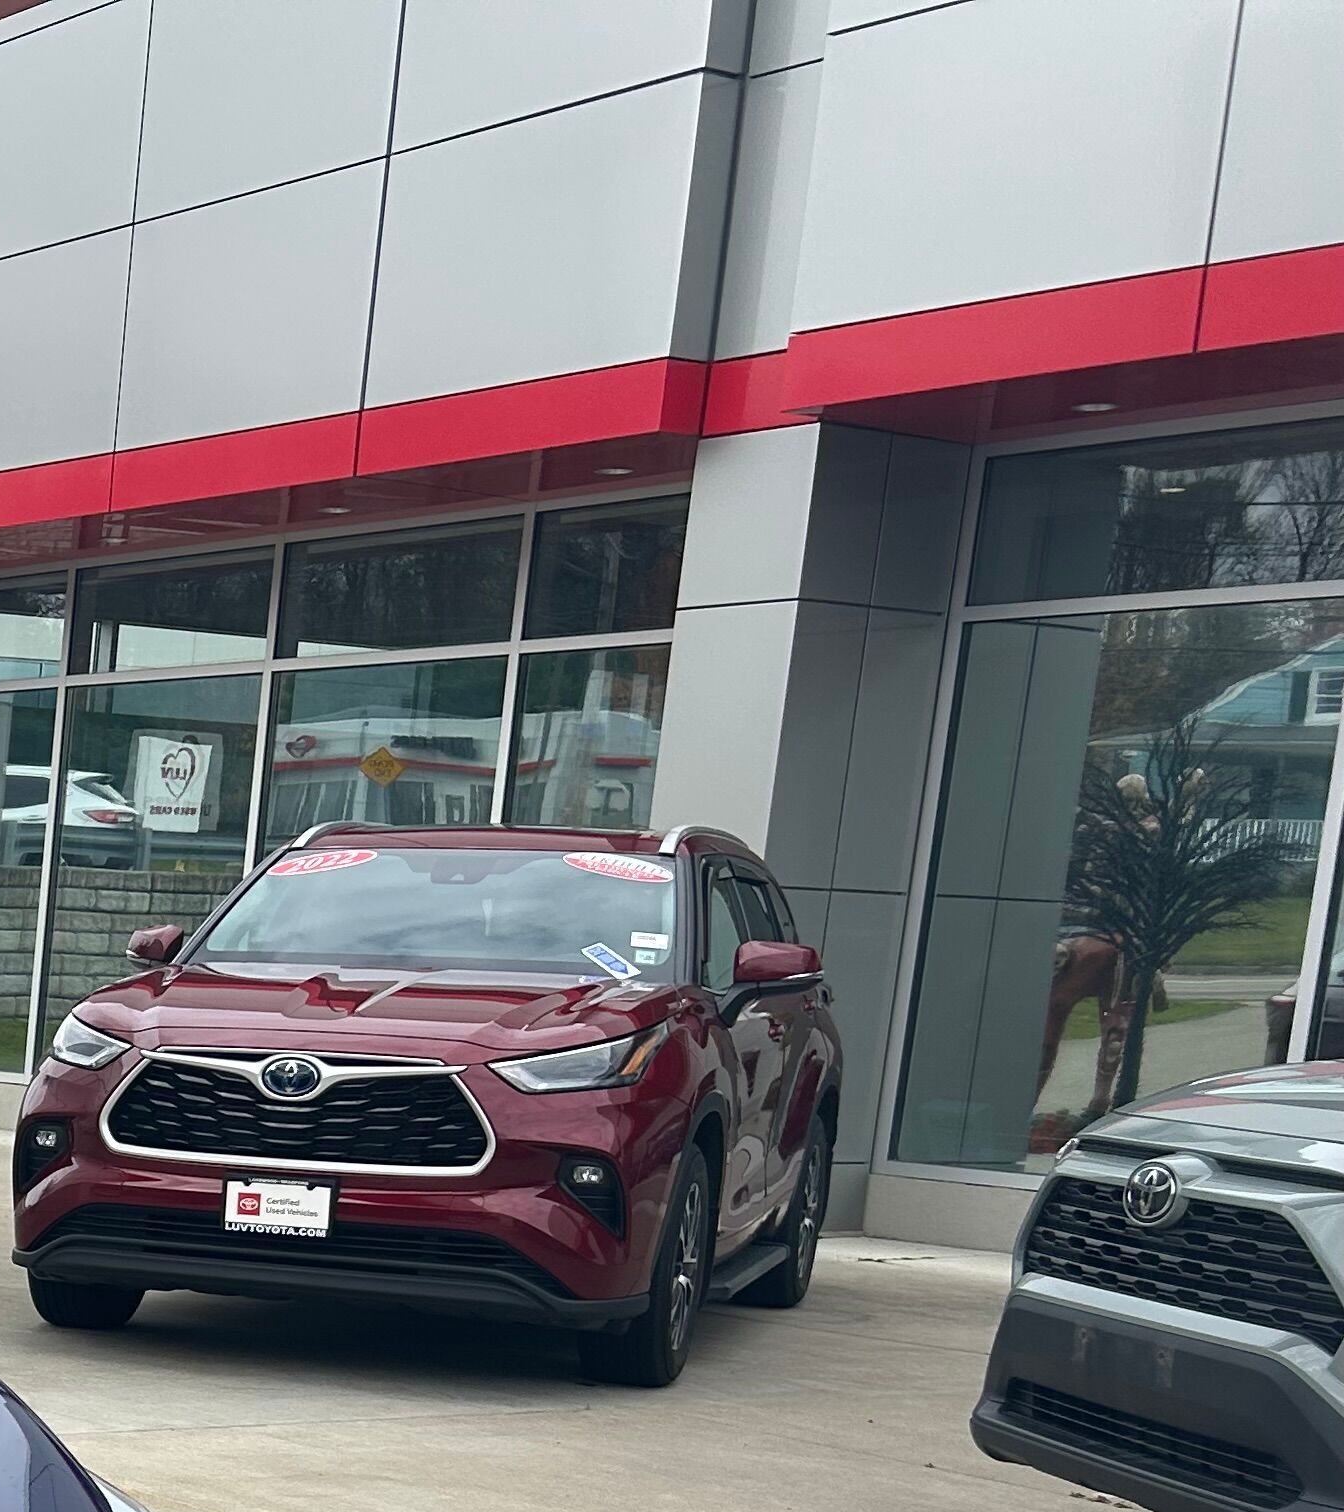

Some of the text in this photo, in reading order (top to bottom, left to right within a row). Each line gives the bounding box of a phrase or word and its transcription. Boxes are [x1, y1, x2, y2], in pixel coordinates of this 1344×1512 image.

[286, 850, 361, 873] 2022
[266, 1197, 300, 1207] Certified
[265, 1207, 319, 1218] Used Vehicles
[224, 1221, 327, 1238] LUVTOYOTA.COM
